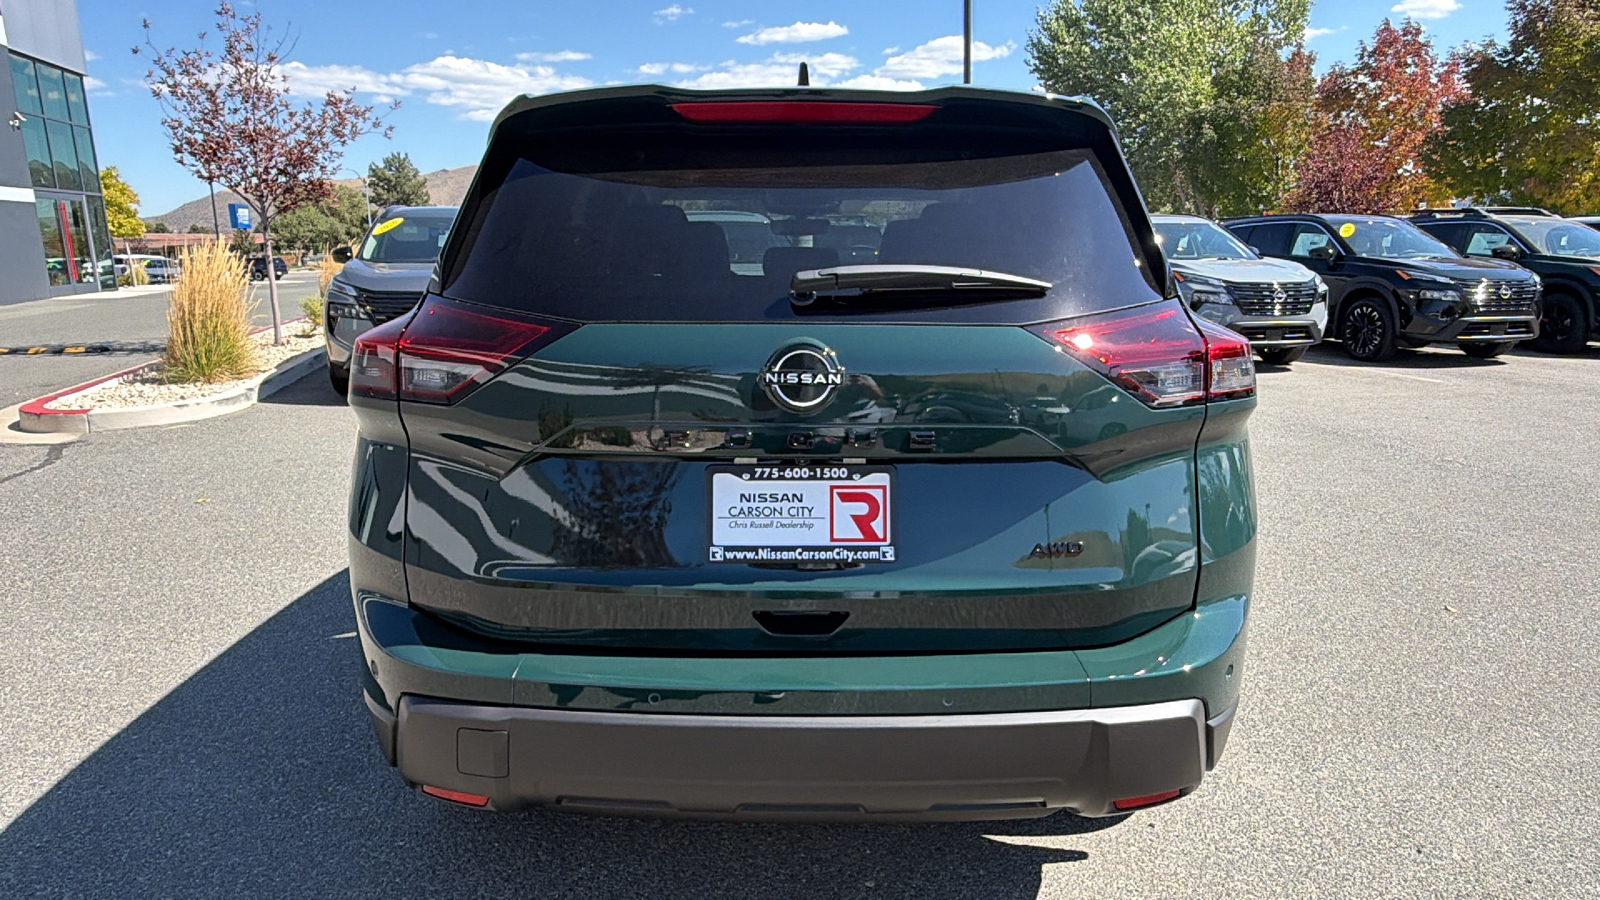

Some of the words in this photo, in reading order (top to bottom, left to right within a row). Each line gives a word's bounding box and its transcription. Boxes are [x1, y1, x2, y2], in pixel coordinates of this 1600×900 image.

[765, 372, 841, 384] NISSAN
[754, 467, 848, 479] 775-600-1500
[739, 493, 803, 503] NISSAN
[728, 506, 783, 517] CARSON
[787, 506, 814, 517] CITY
[728, 520, 748, 529] Chris
[750, 520, 774, 529] Russell
[775, 520, 814, 530] Dealership
[725, 548, 879, 562] www.NissanCarsonCity.com
[1028, 541, 1084, 559] AWD
